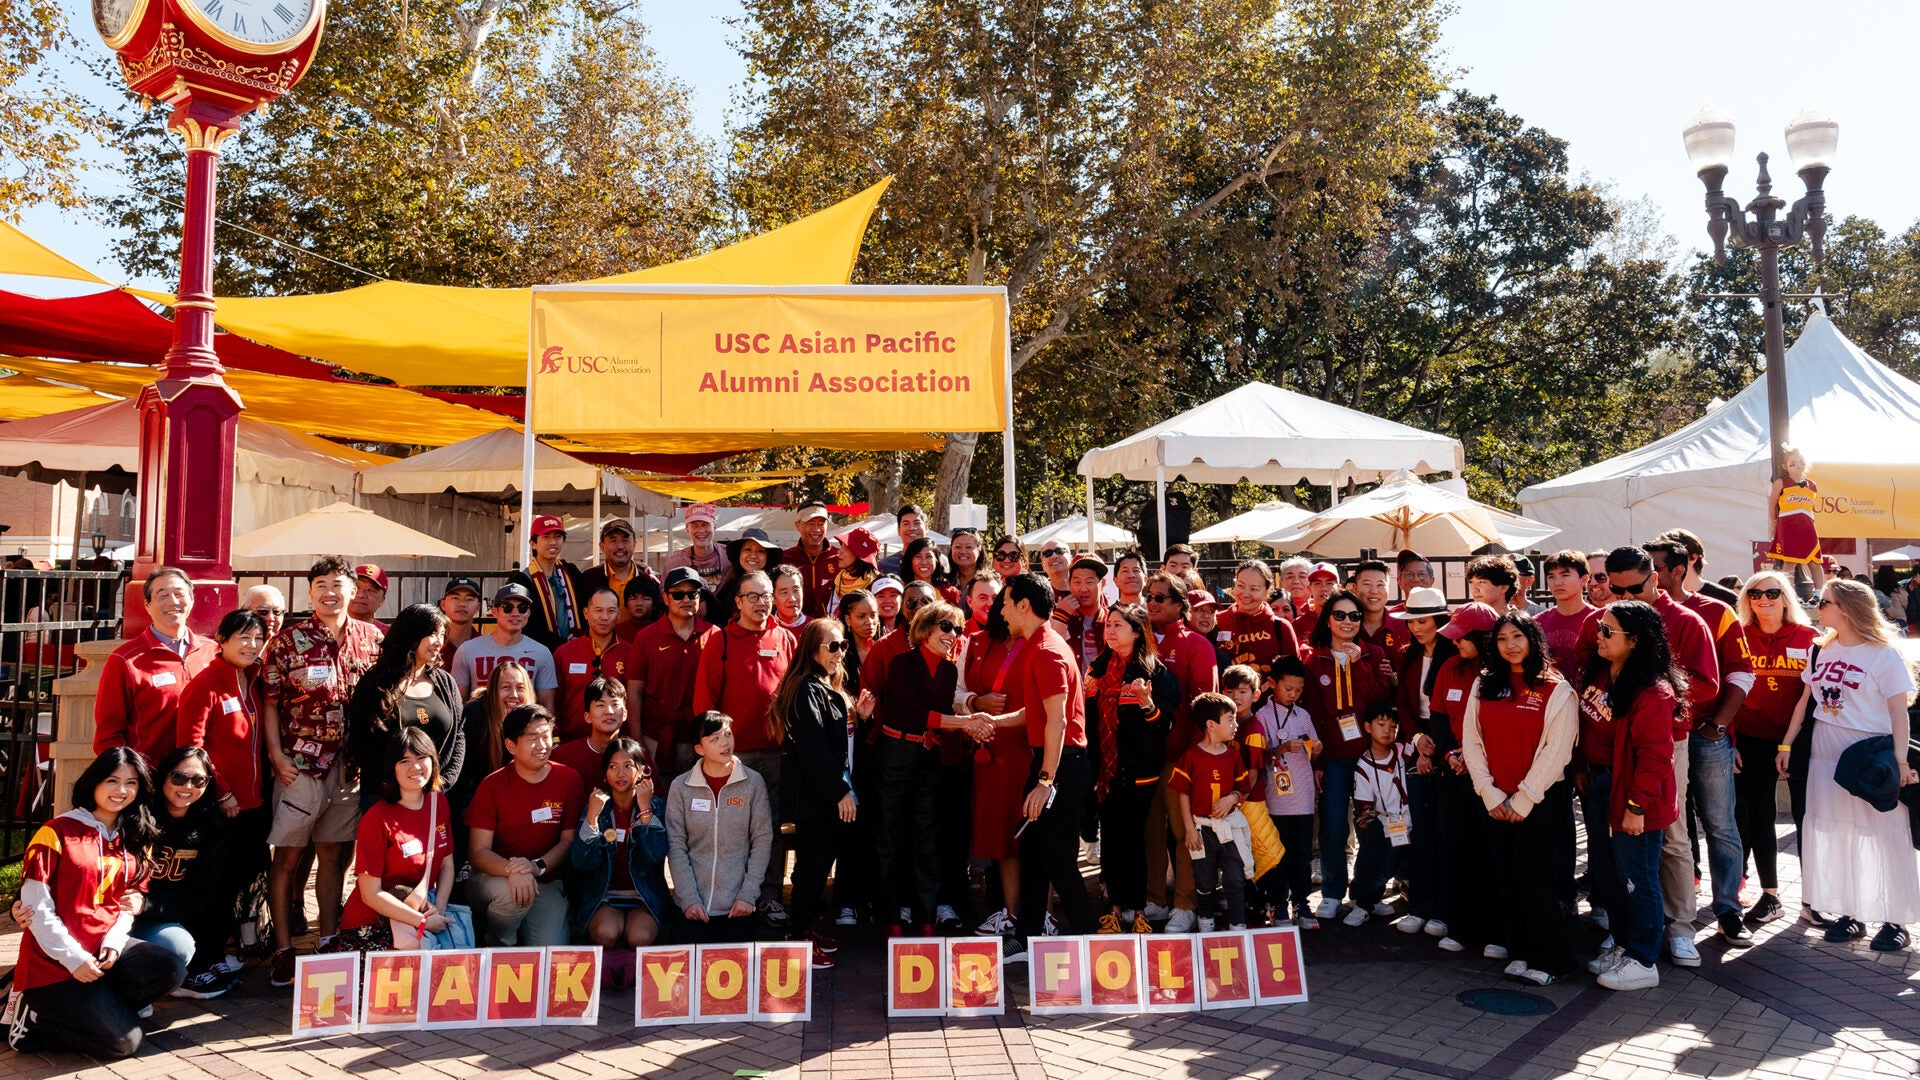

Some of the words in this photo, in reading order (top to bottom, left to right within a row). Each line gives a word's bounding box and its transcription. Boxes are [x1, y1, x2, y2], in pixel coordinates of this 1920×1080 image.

[714, 333, 770, 354] USC
[779, 331, 856, 354] Asian
[866, 330, 956, 354] Pacific
[567, 356, 609, 374] USC
[610, 357, 638, 365] Alumni
[610, 366, 651, 374] Association
[699, 370, 799, 393] Alumni
[808, 370, 971, 394] Association
[1850, 498, 1874, 506] Alumni
[1850, 507, 1886, 515] Association
[475, 655, 536, 681] UC
[726, 797, 744, 807] USC
[93, 856, 121, 905] 7
[308, 962, 591, 1018] THANK
[646, 959, 800, 1001] YOU
[899, 953, 994, 994] DR
[1044, 944, 1286, 990] FOLT!
